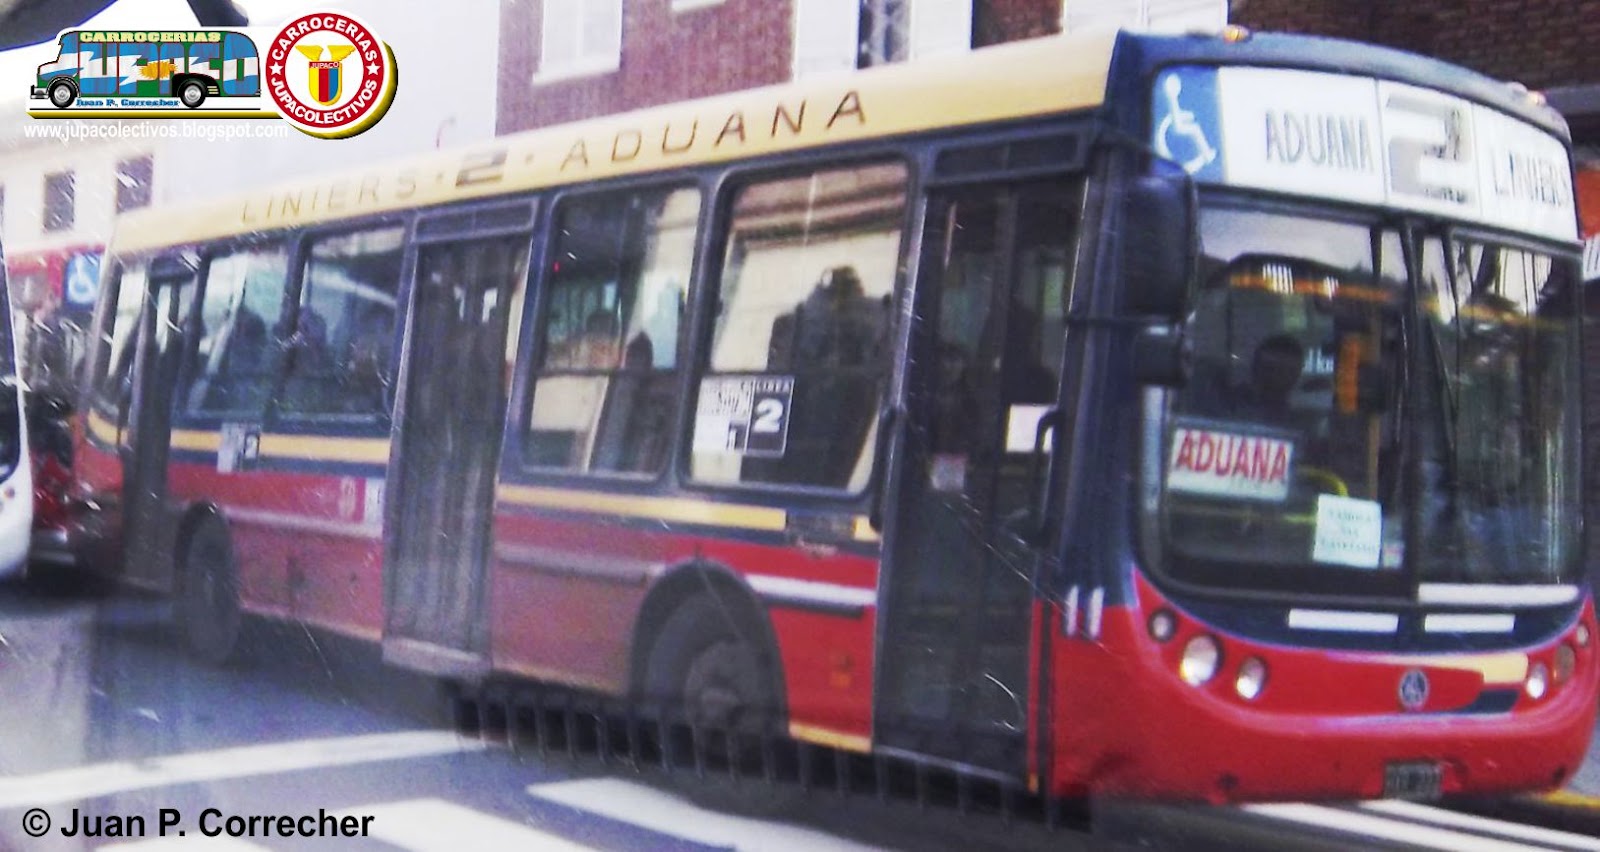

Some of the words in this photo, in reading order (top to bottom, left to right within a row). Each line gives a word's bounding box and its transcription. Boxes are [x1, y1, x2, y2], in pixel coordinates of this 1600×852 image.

[241, 173, 418, 222] LINIERS
[560, 90, 867, 171] ADUANA
[1264, 110, 1373, 172] ADUANA
[752, 399, 784, 433] 2
[1177, 431, 1288, 482] ADUANA
